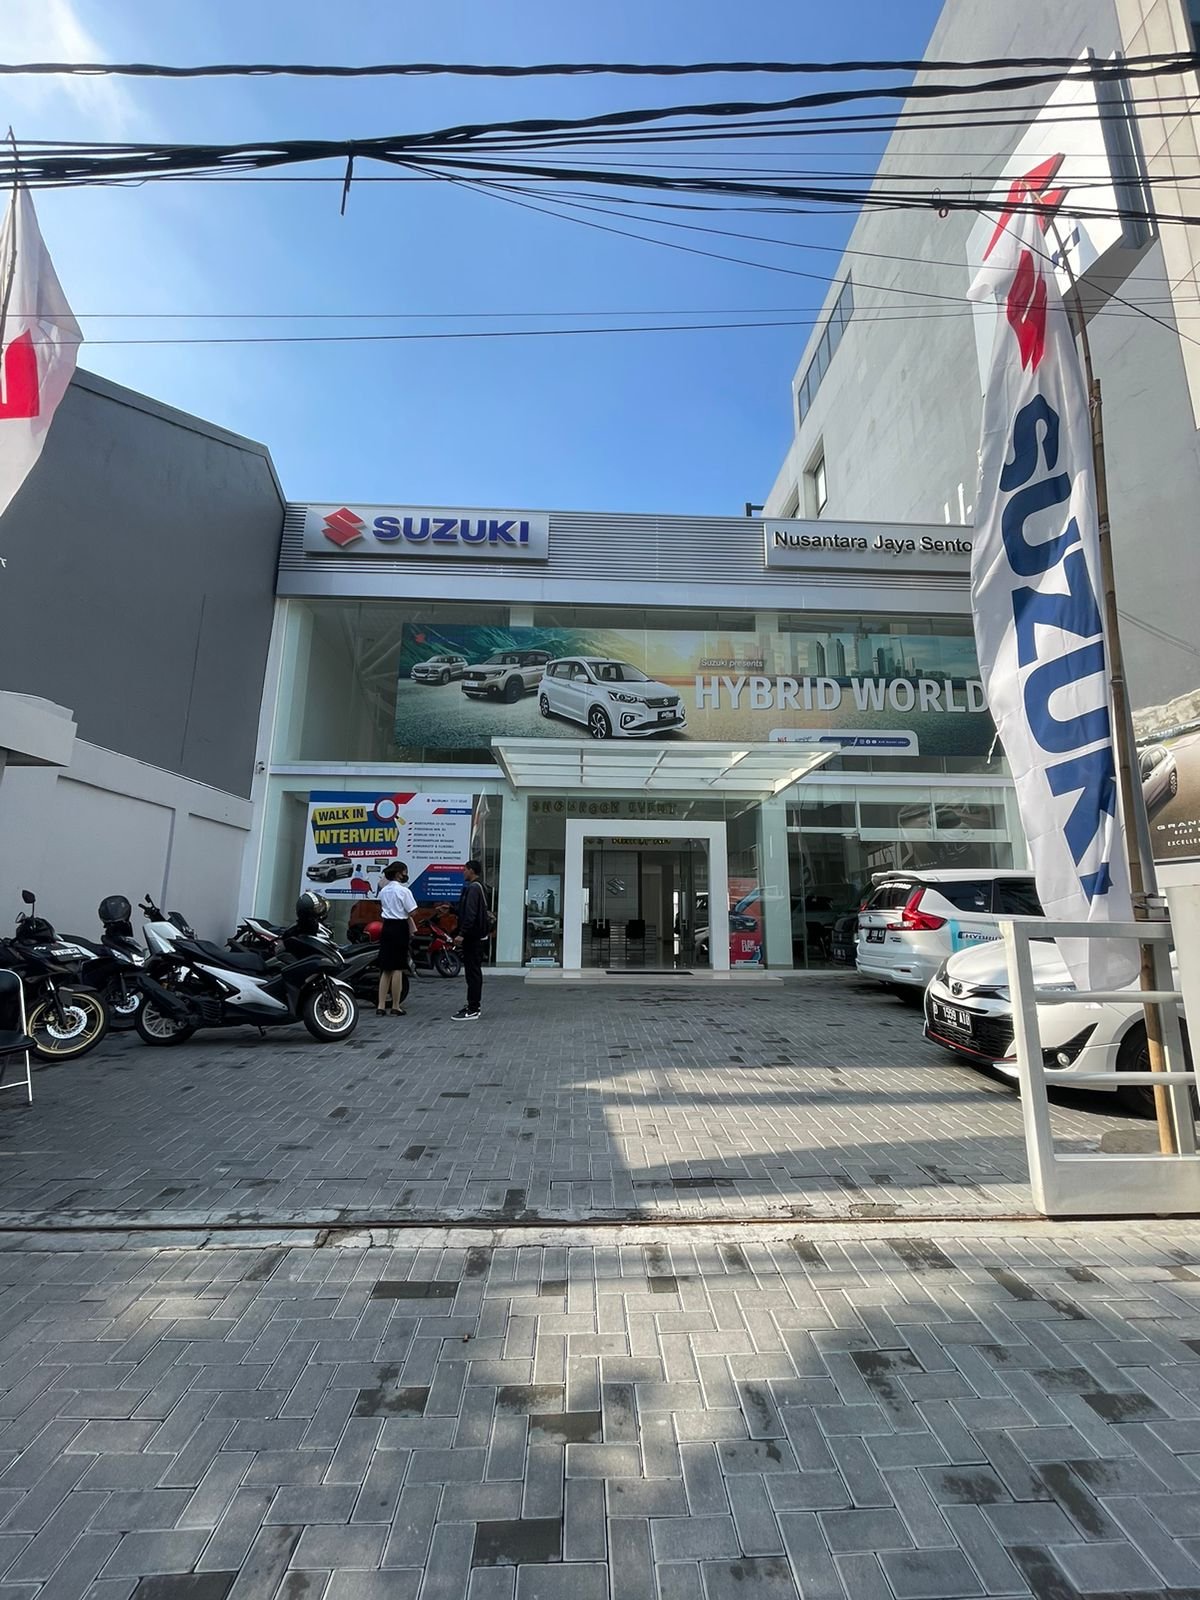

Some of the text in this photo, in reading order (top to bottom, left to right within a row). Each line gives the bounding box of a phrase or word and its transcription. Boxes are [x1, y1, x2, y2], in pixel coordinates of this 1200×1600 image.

[372, 516, 530, 545] SUZUKI
[774, 531, 973, 554] Nusantara Jaya Sento
[1000, 393, 1117, 906] SUZUKI
[702, 658, 763, 668] Suzuki presents
[695, 675, 989, 714] HYBRID WORLD
[318, 808, 364, 821] WALK IN
[314, 827, 398, 844] INTERVIEW
[1157, 820, 1200, 831] GRAN
